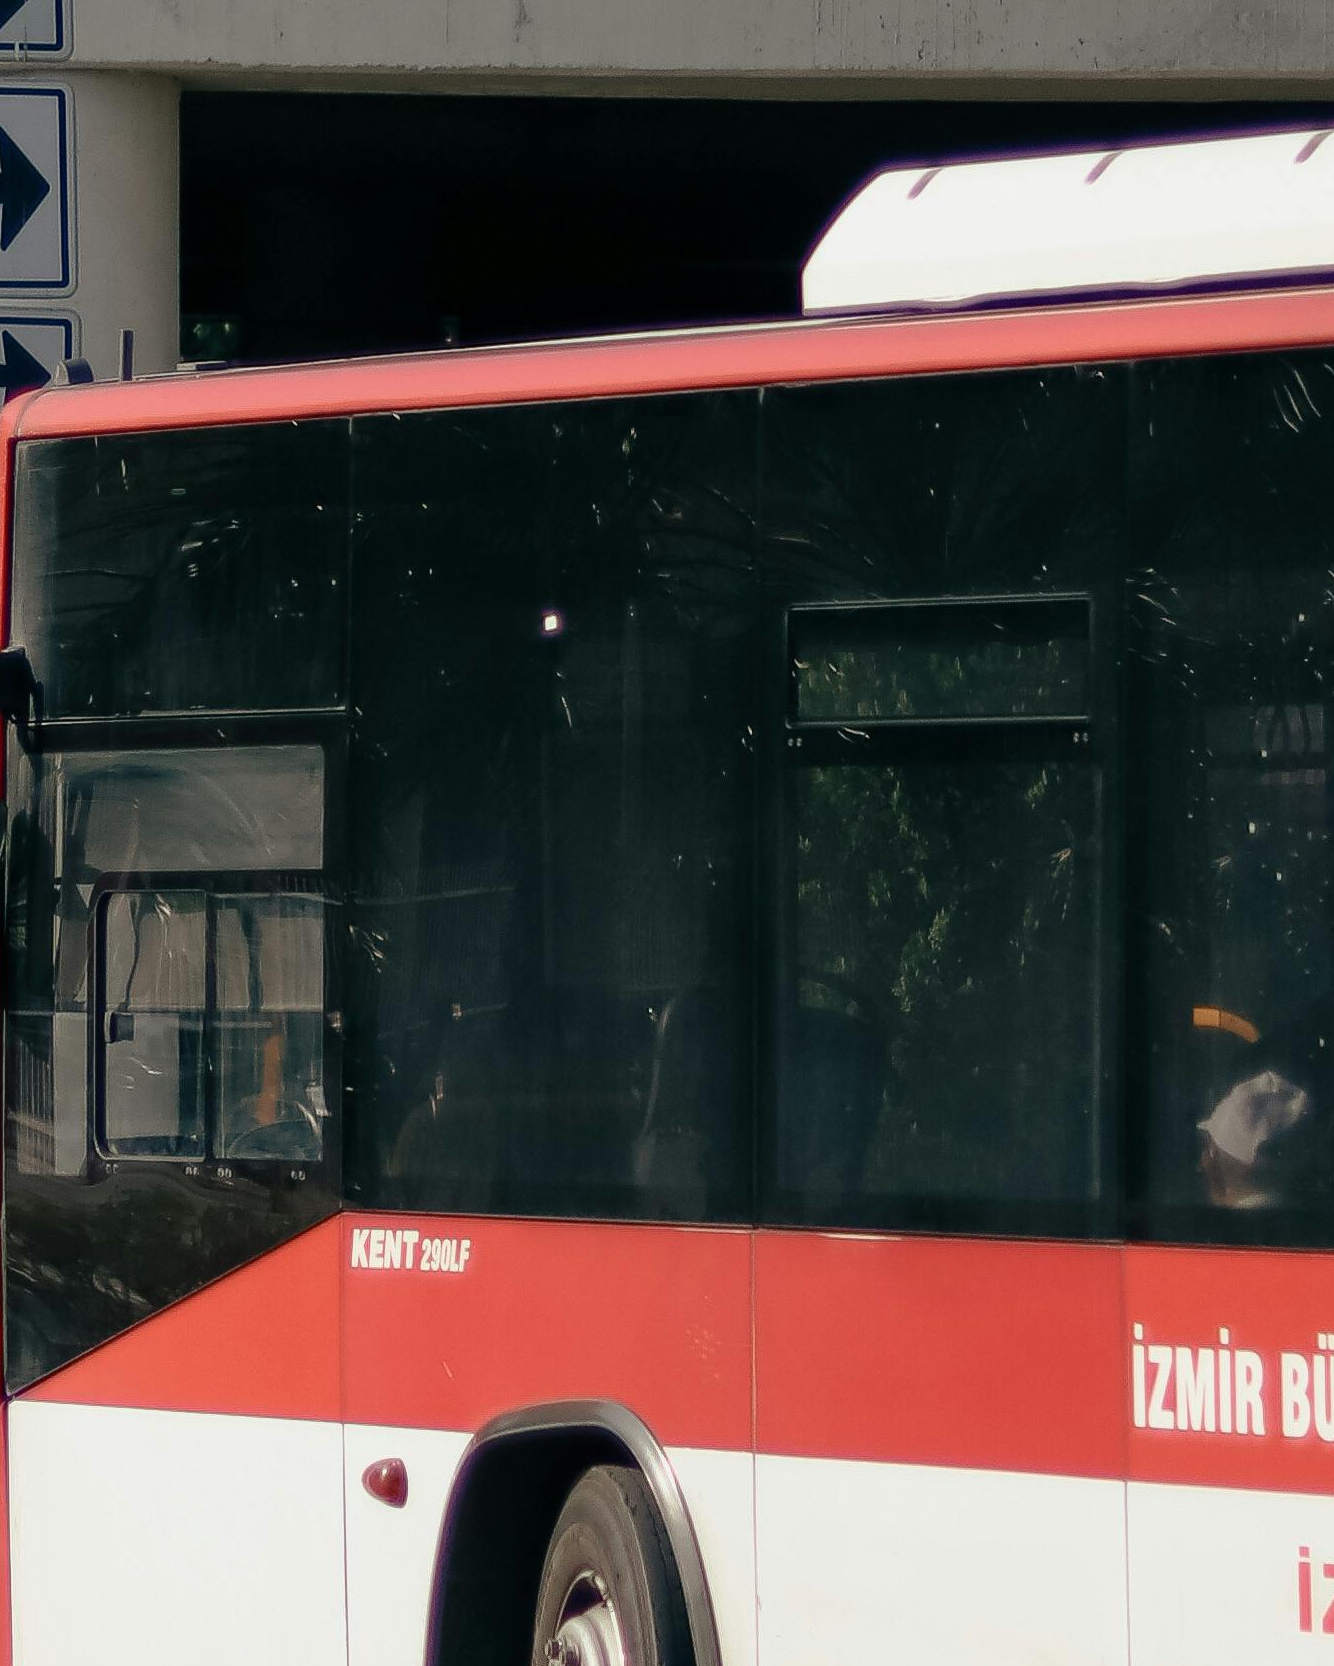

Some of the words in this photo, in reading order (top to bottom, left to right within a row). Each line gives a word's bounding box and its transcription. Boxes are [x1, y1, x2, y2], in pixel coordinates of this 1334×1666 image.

[351, 1228, 419, 1270] KENT
[420, 1237, 471, 1273] 290LF
[1131, 1322, 1266, 1437] İZMİR
